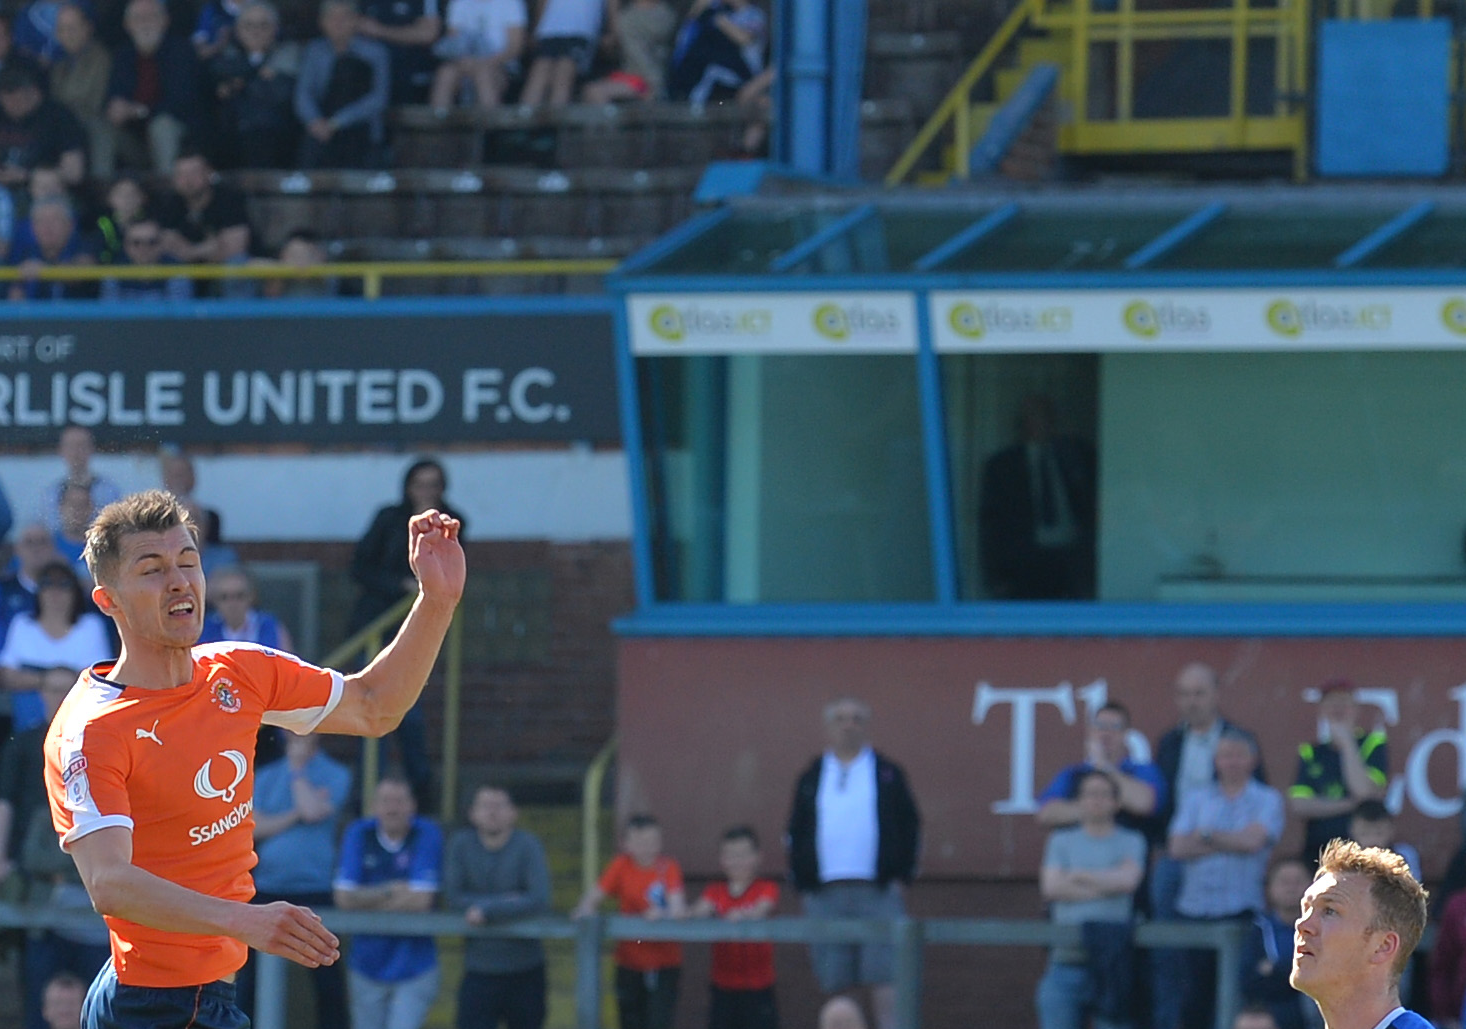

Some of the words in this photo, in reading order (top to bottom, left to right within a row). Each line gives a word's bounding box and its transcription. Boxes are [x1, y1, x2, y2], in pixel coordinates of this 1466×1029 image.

[35, 335, 76, 362] OF
[203, 369, 445, 426] UNITED
[462, 367, 571, 423] F.C.
